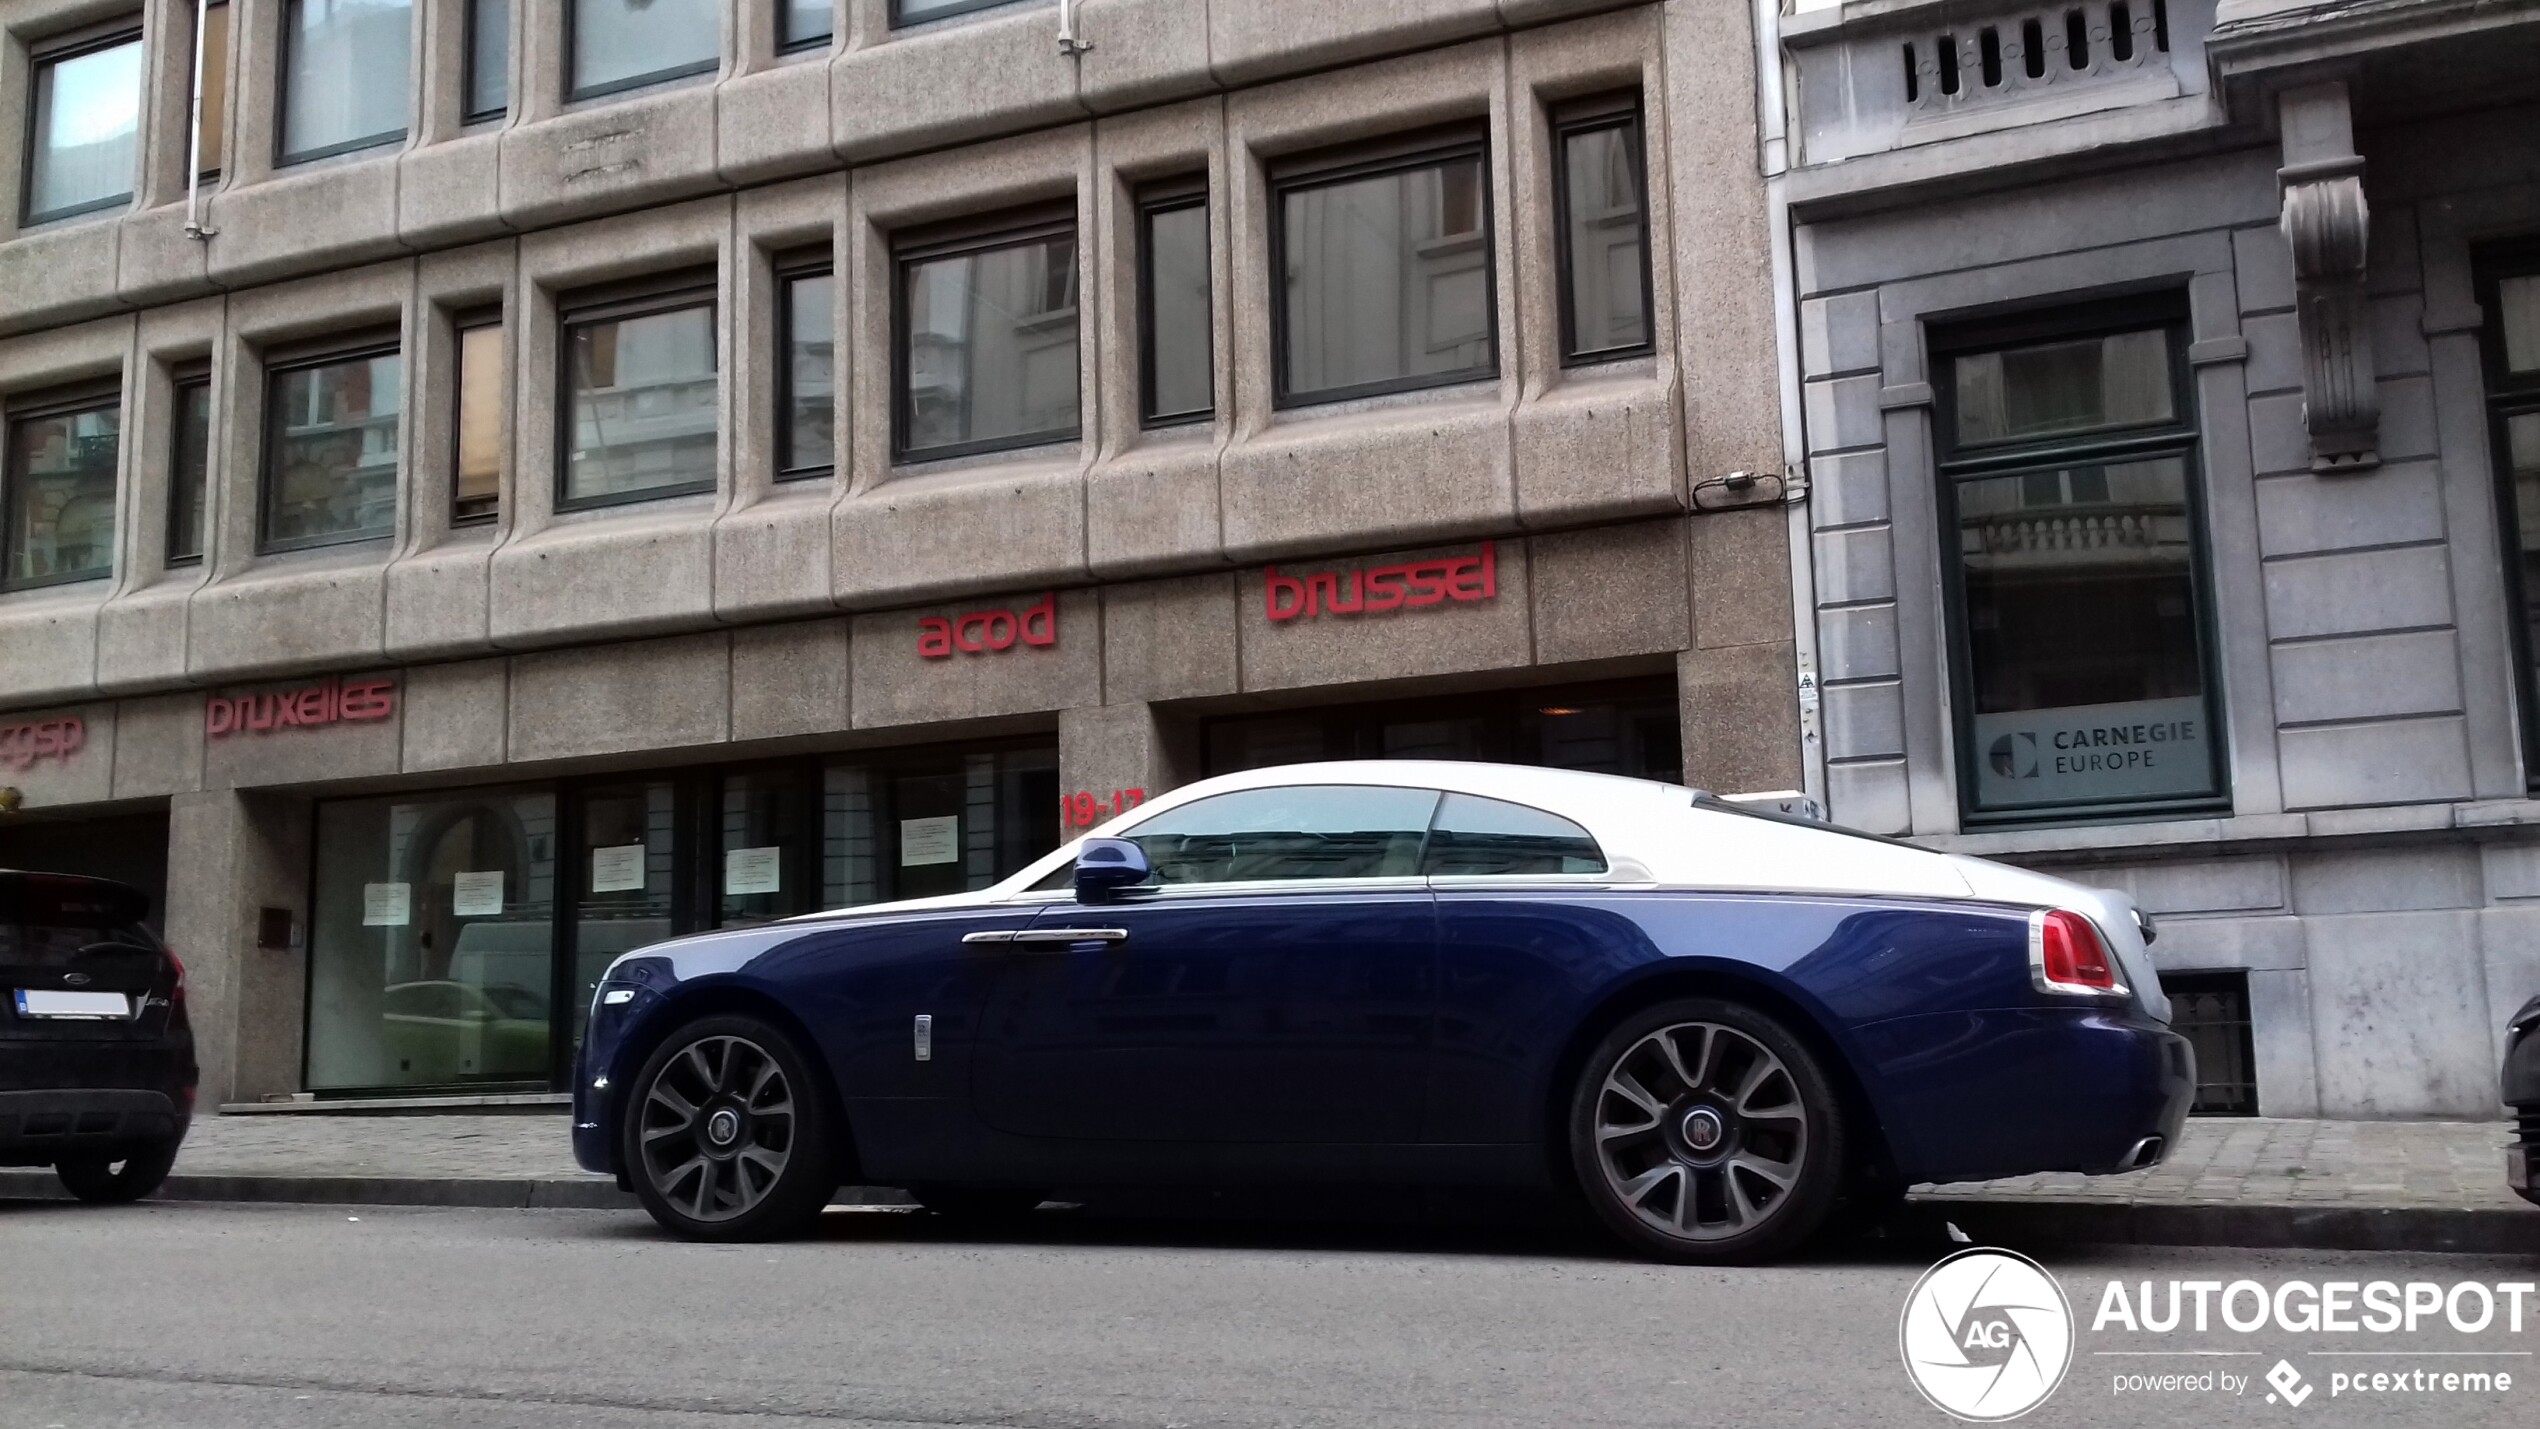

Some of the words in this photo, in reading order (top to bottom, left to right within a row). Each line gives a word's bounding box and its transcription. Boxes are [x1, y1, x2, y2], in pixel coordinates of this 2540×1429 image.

[1266, 541, 1497, 621] brussel
[918, 593, 1057, 657] acod
[2054, 721, 2196, 749] CARNEGIE
[2056, 750, 2155, 773] EUROPE
